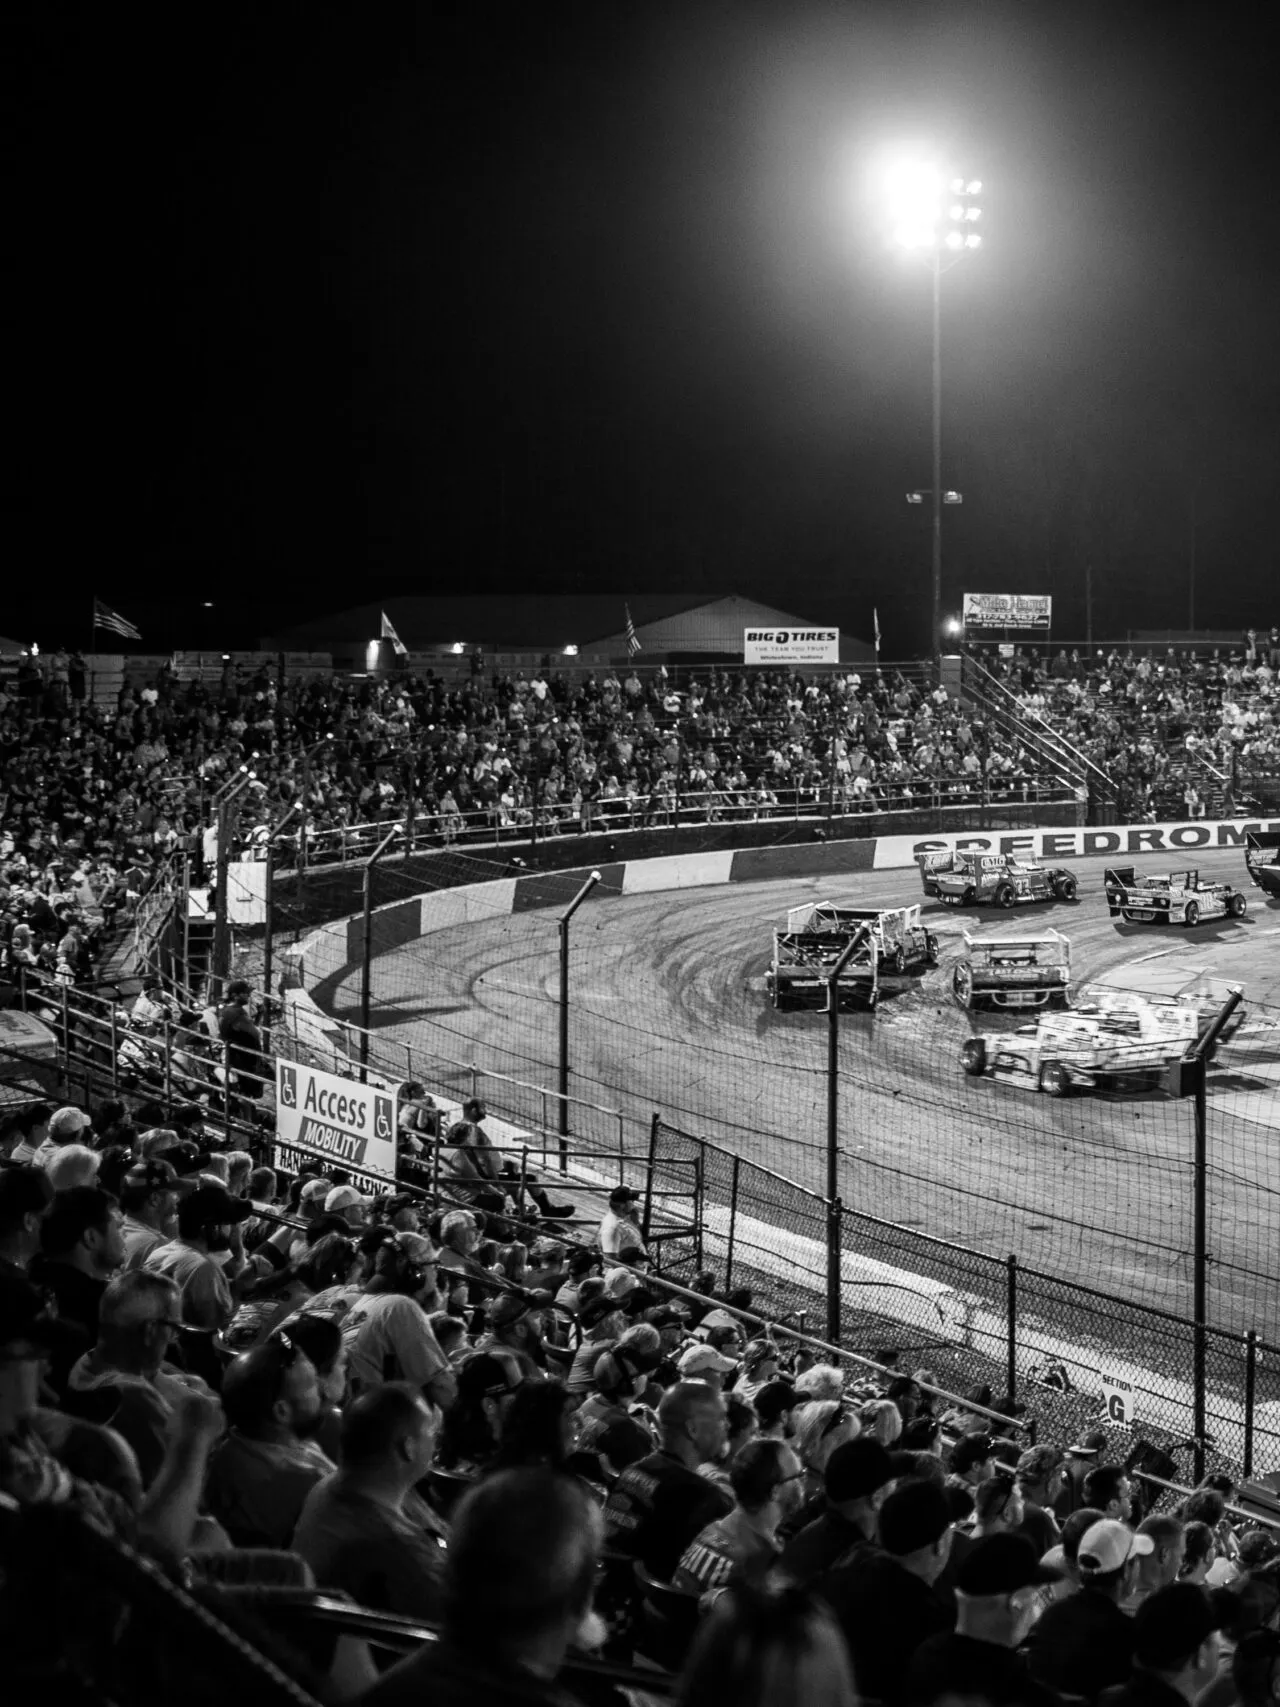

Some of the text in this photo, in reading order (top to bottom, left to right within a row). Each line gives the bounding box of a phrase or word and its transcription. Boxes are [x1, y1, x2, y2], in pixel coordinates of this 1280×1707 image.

[747, 632, 774, 642] BIG
[791, 632, 836, 642] TIRES
[304, 1076, 367, 1129] Access
[304, 1120, 361, 1161] MOBILITY
[1102, 1374, 1132, 1393] SECTION
[1108, 1394, 1125, 1423] G
